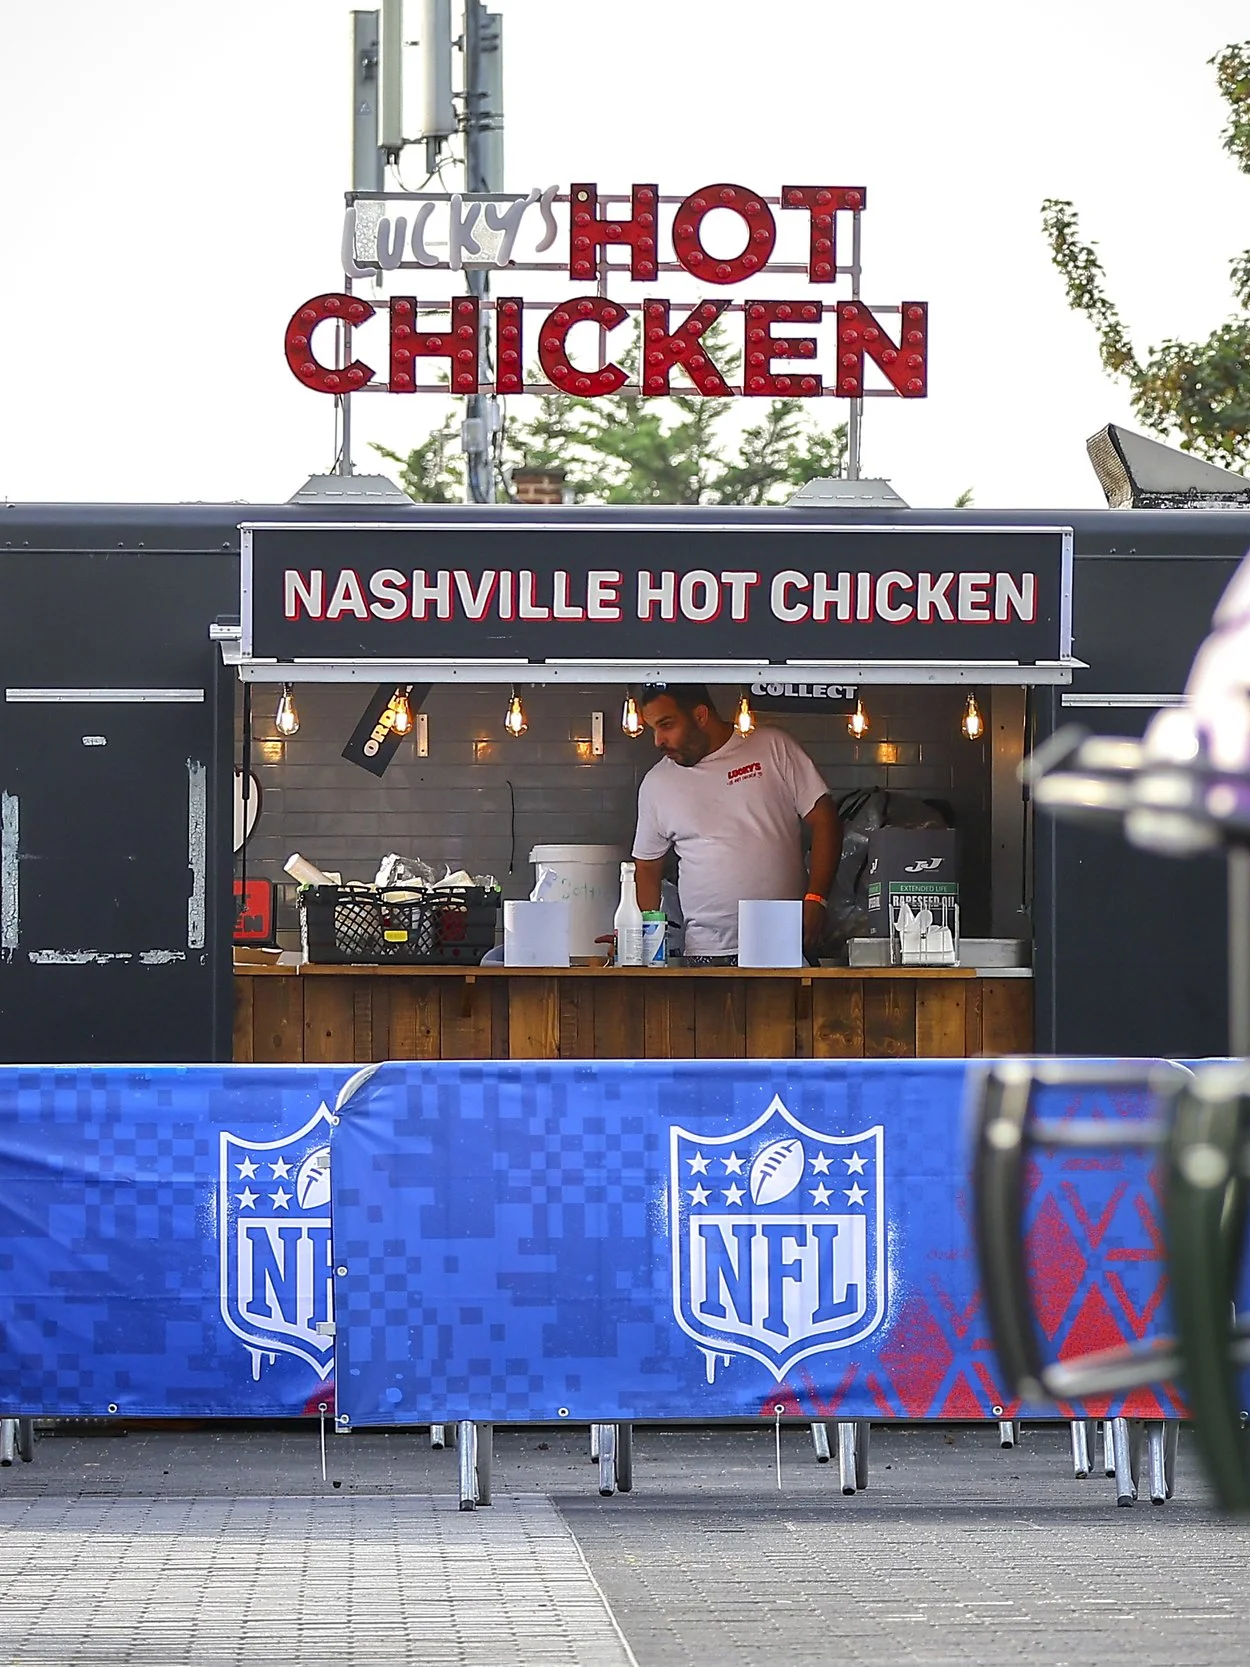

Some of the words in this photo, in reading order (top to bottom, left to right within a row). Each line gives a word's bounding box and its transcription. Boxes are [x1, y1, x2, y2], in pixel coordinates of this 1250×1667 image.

[569, 183, 867, 284] HOT
[284, 292, 928, 398] CHICKEN
[284, 569, 623, 622] NASHVILLE
[636, 570, 760, 624] HOT
[770, 569, 1037, 624] CHICKEN
[750, 683, 858, 699] COLLECT
[904, 857, 944, 873] JJ
[935, 885, 948, 893] LIFE
[698, 1223, 860, 1338] NFL
